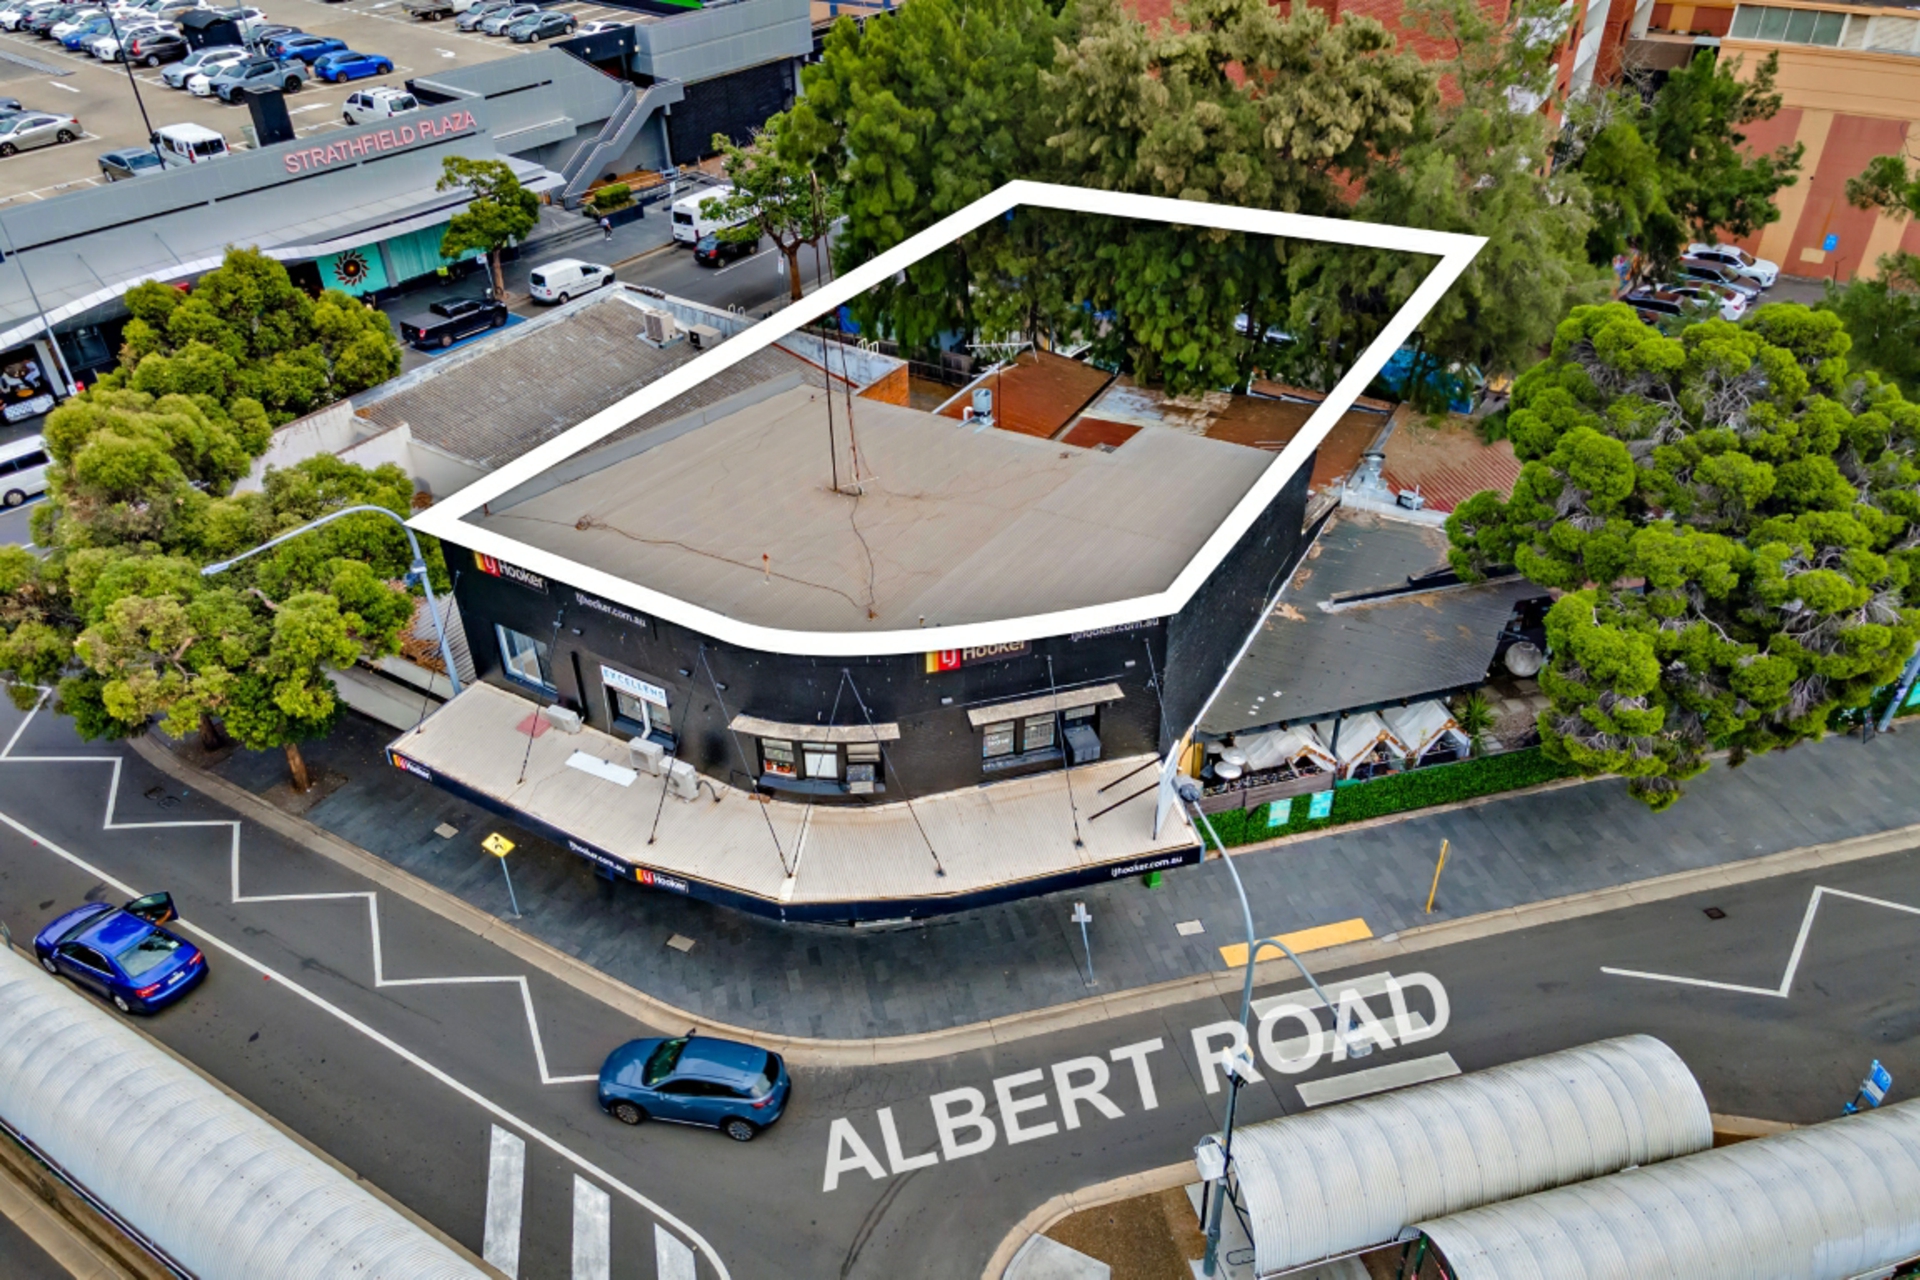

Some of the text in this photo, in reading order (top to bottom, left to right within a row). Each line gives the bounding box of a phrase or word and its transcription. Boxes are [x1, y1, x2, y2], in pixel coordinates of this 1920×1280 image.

[284, 110, 477, 174] STRATHFIELD PLAZA
[498, 560, 543, 588] Hooker
[962, 640, 1026, 661] Hooker
[1111, 856, 1183, 877] ljhooker.com.au
